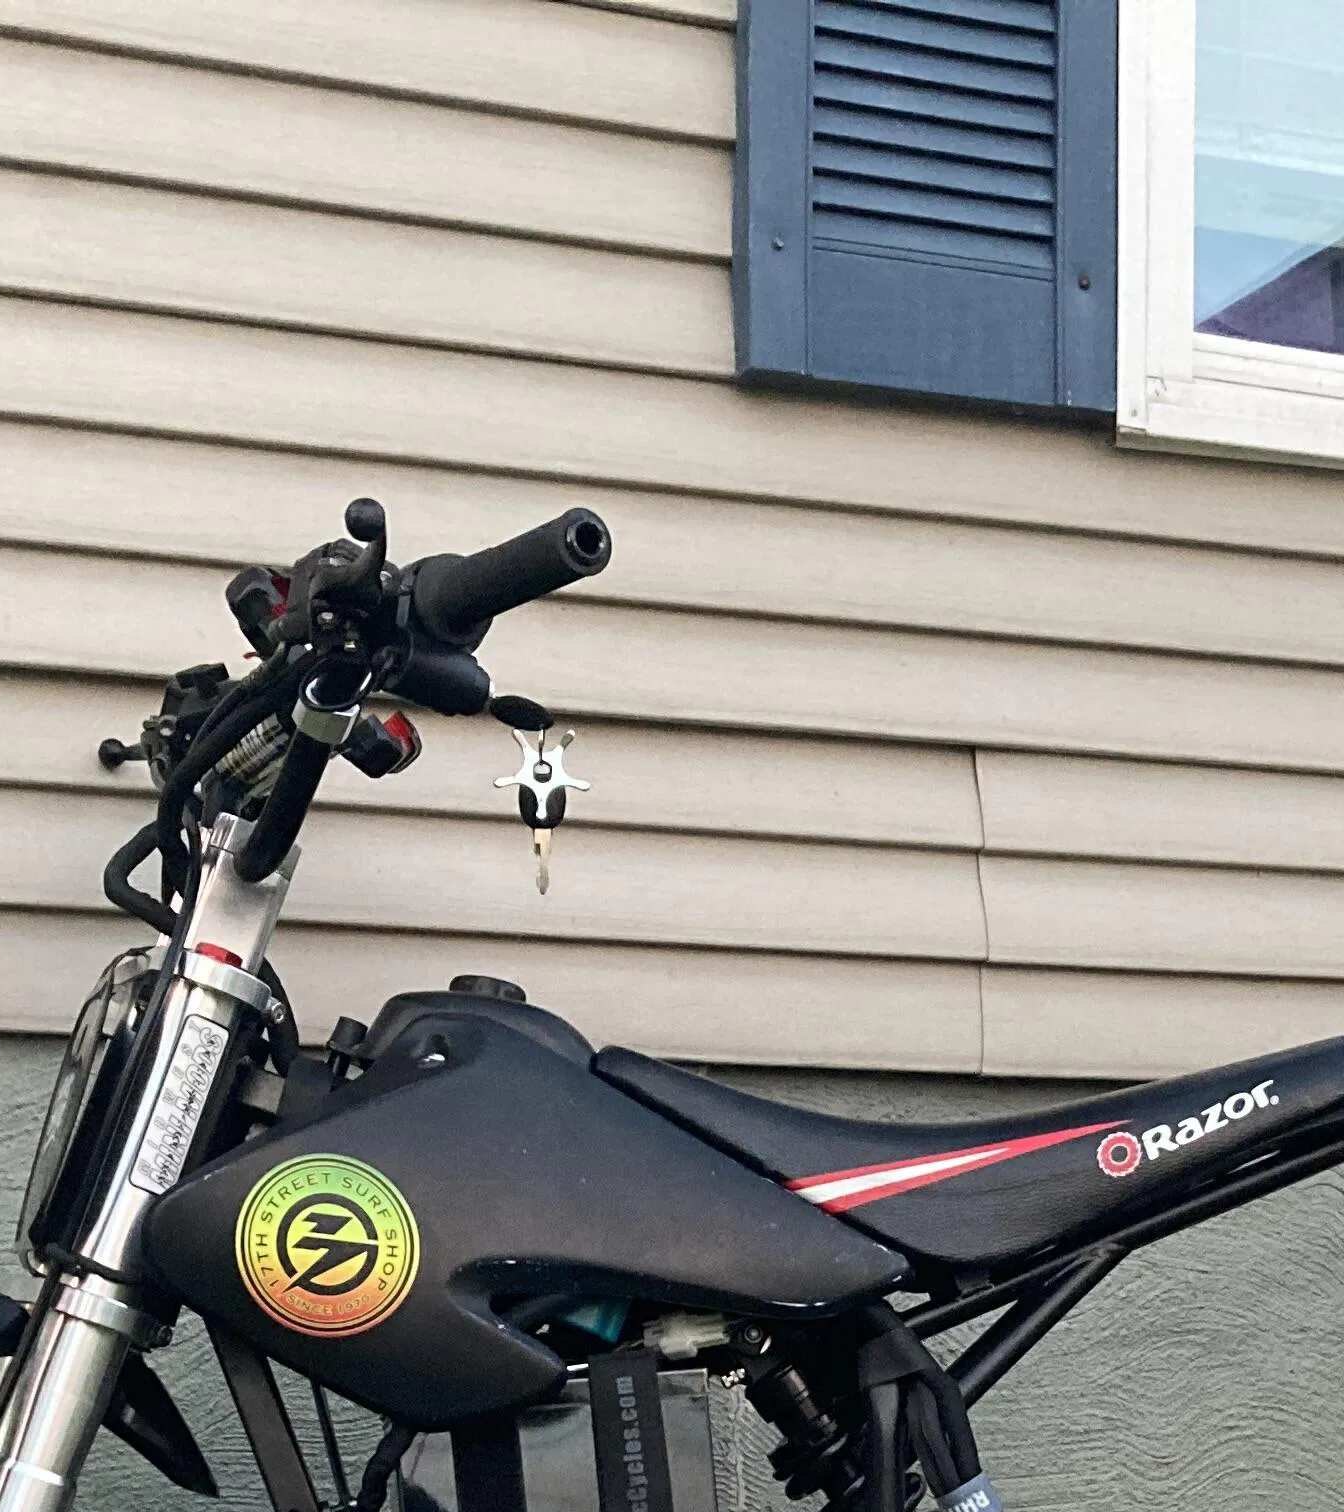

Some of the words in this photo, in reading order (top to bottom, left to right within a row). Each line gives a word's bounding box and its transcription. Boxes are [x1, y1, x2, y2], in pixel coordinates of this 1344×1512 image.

[150, 1114, 193, 1190] MINI
[175, 1026, 224, 1121] MODS
[260, 1172, 331, 1224] STREET
[342, 1176, 392, 1218] SURF
[255, 1233, 279, 1287] 17TH
[377, 1228, 398, 1292] SHOP
[286, 1293, 333, 1316] SINCE
